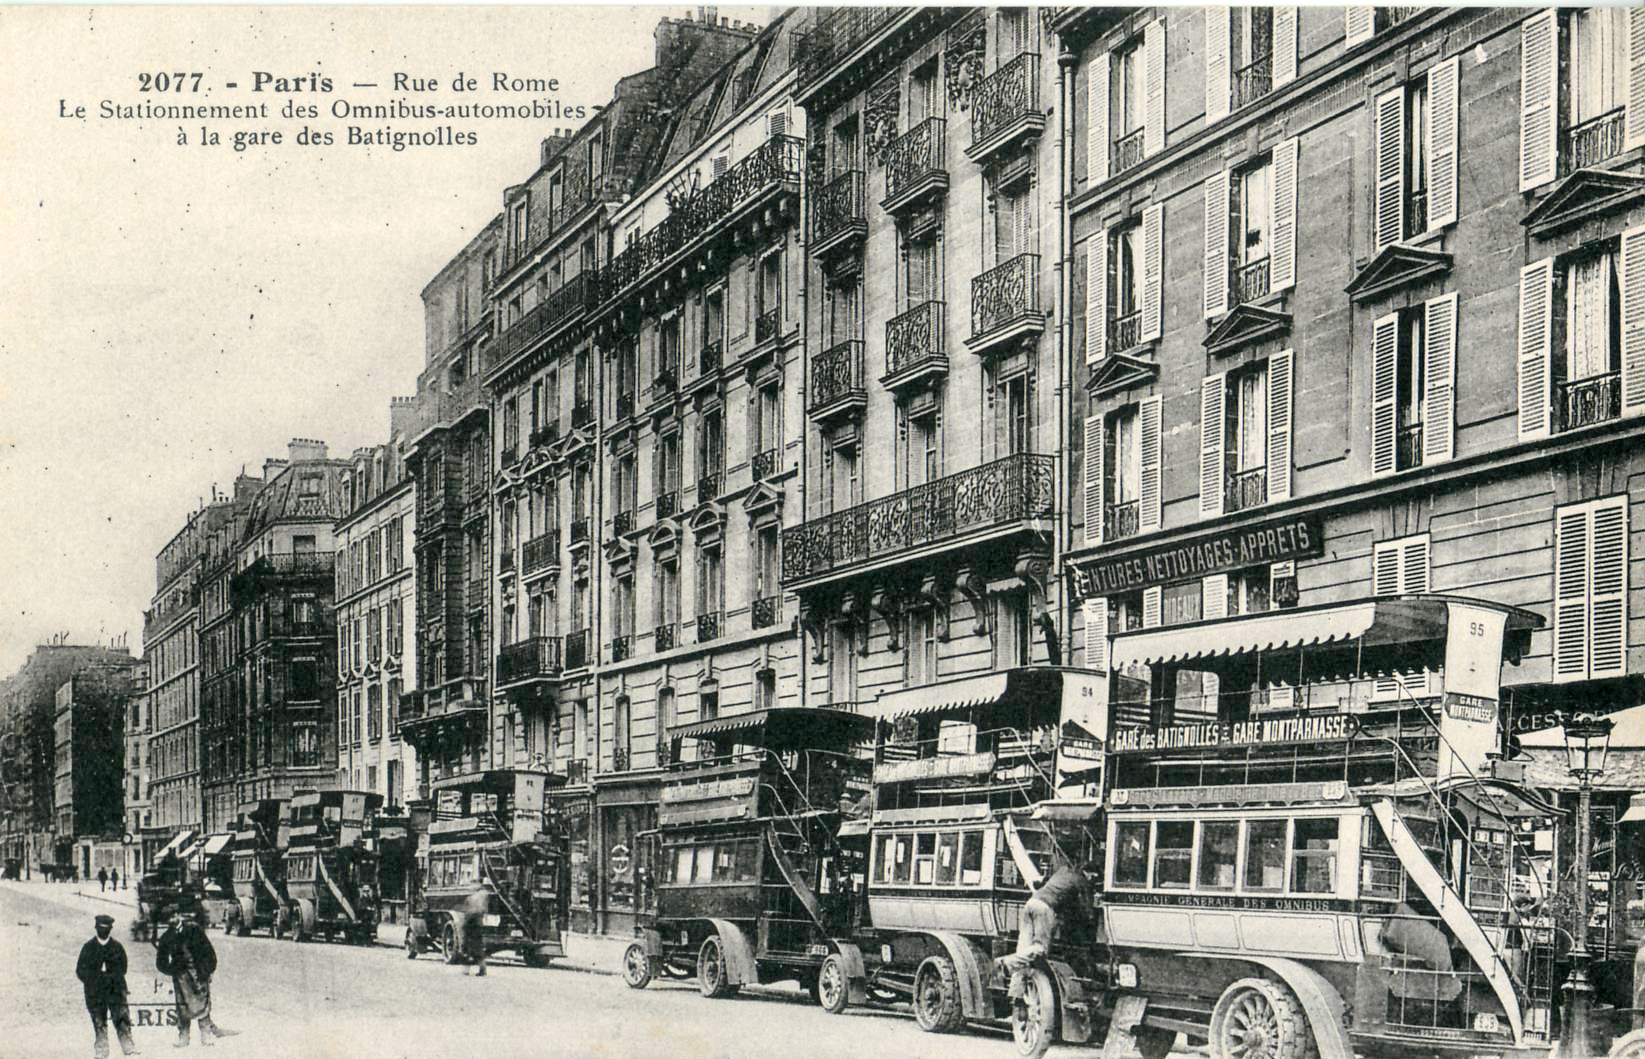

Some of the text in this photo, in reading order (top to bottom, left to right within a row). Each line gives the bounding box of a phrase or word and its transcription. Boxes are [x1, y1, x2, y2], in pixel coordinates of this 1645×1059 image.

[1146, 541, 1233, 580] NETTOYAGES
[1239, 522, 1310, 563] APPRETS
[1470, 622, 1485, 637] 95
[1459, 696, 1484, 707] GARE
[1115, 715, 1348, 751] GARE des BATIGNOLLES GARE MONTPARNASSE
[1243, 898, 1267, 909] DES
[1275, 900, 1330, 912] OMNIBUS
